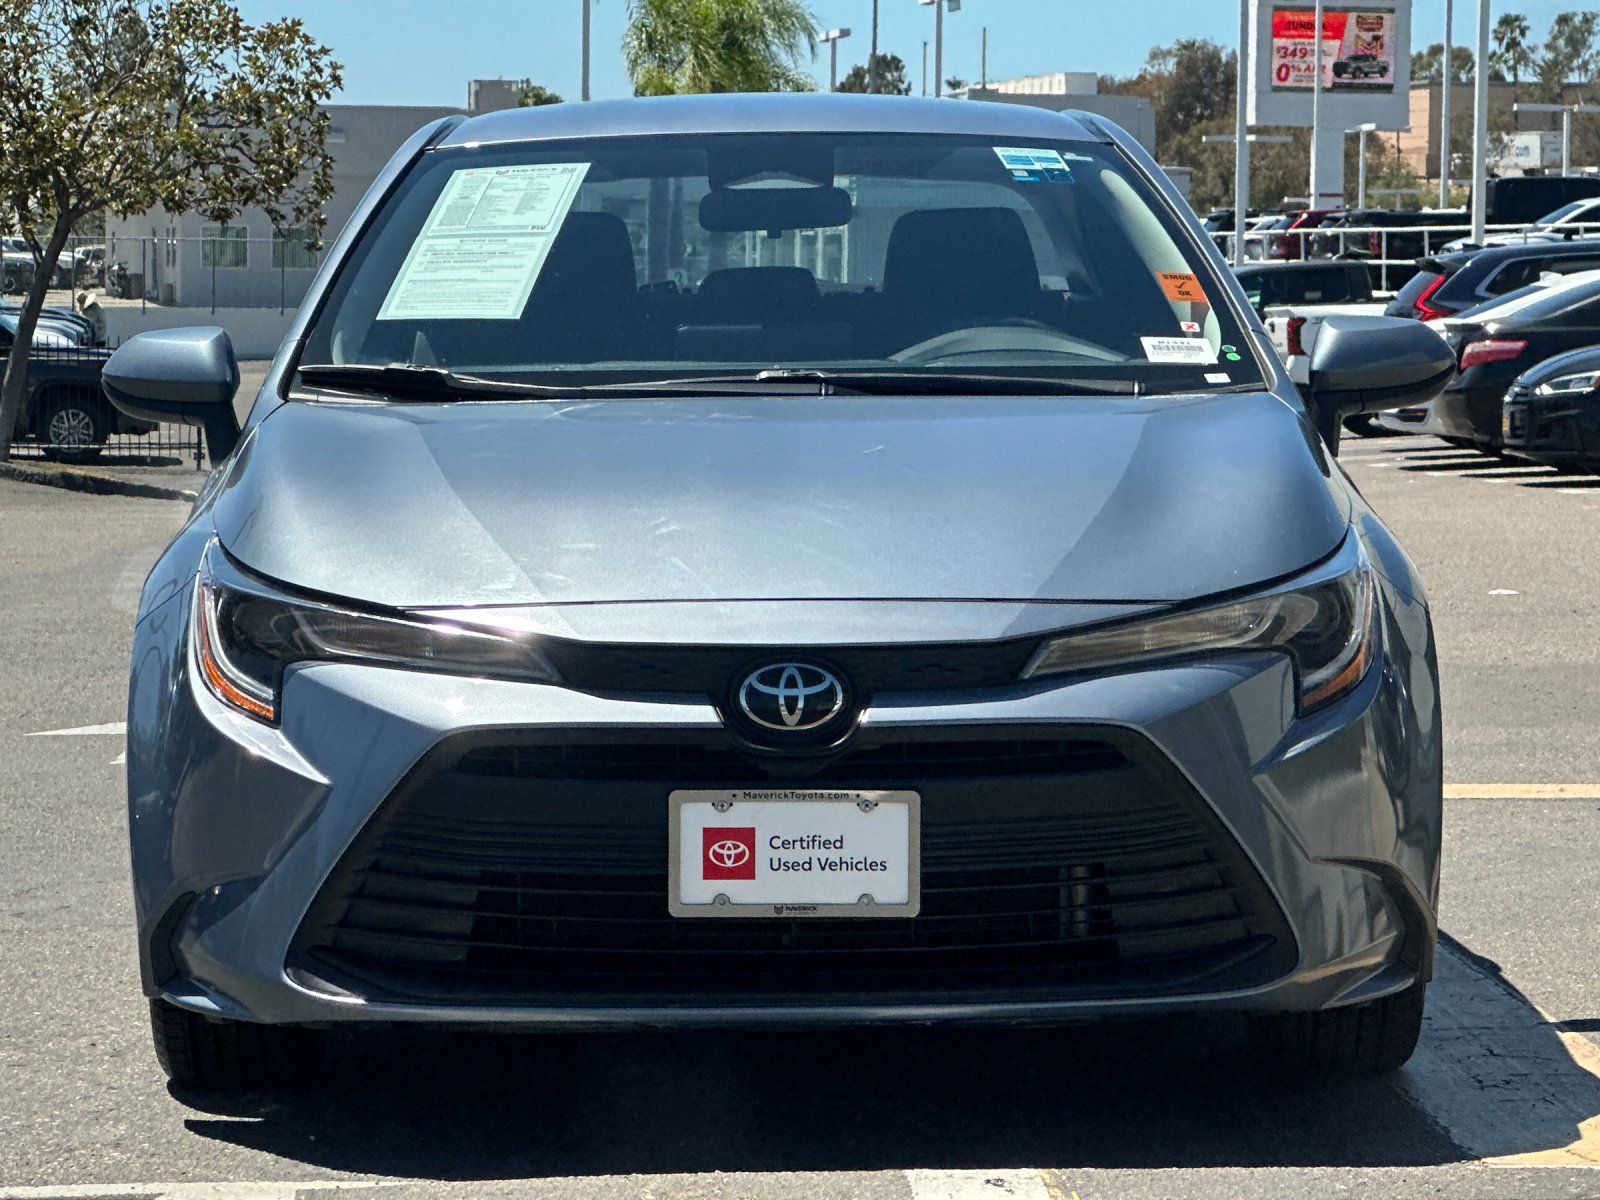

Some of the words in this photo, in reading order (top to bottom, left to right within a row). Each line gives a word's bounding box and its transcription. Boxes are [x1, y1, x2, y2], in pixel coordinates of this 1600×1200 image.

[1287, 21, 1326, 30] TUNDA
[743, 791, 850, 800] MaverickToyota.com
[769, 835, 844, 849] Certified
[769, 857, 812, 871] Used
[817, 857, 887, 871] Vehicles
